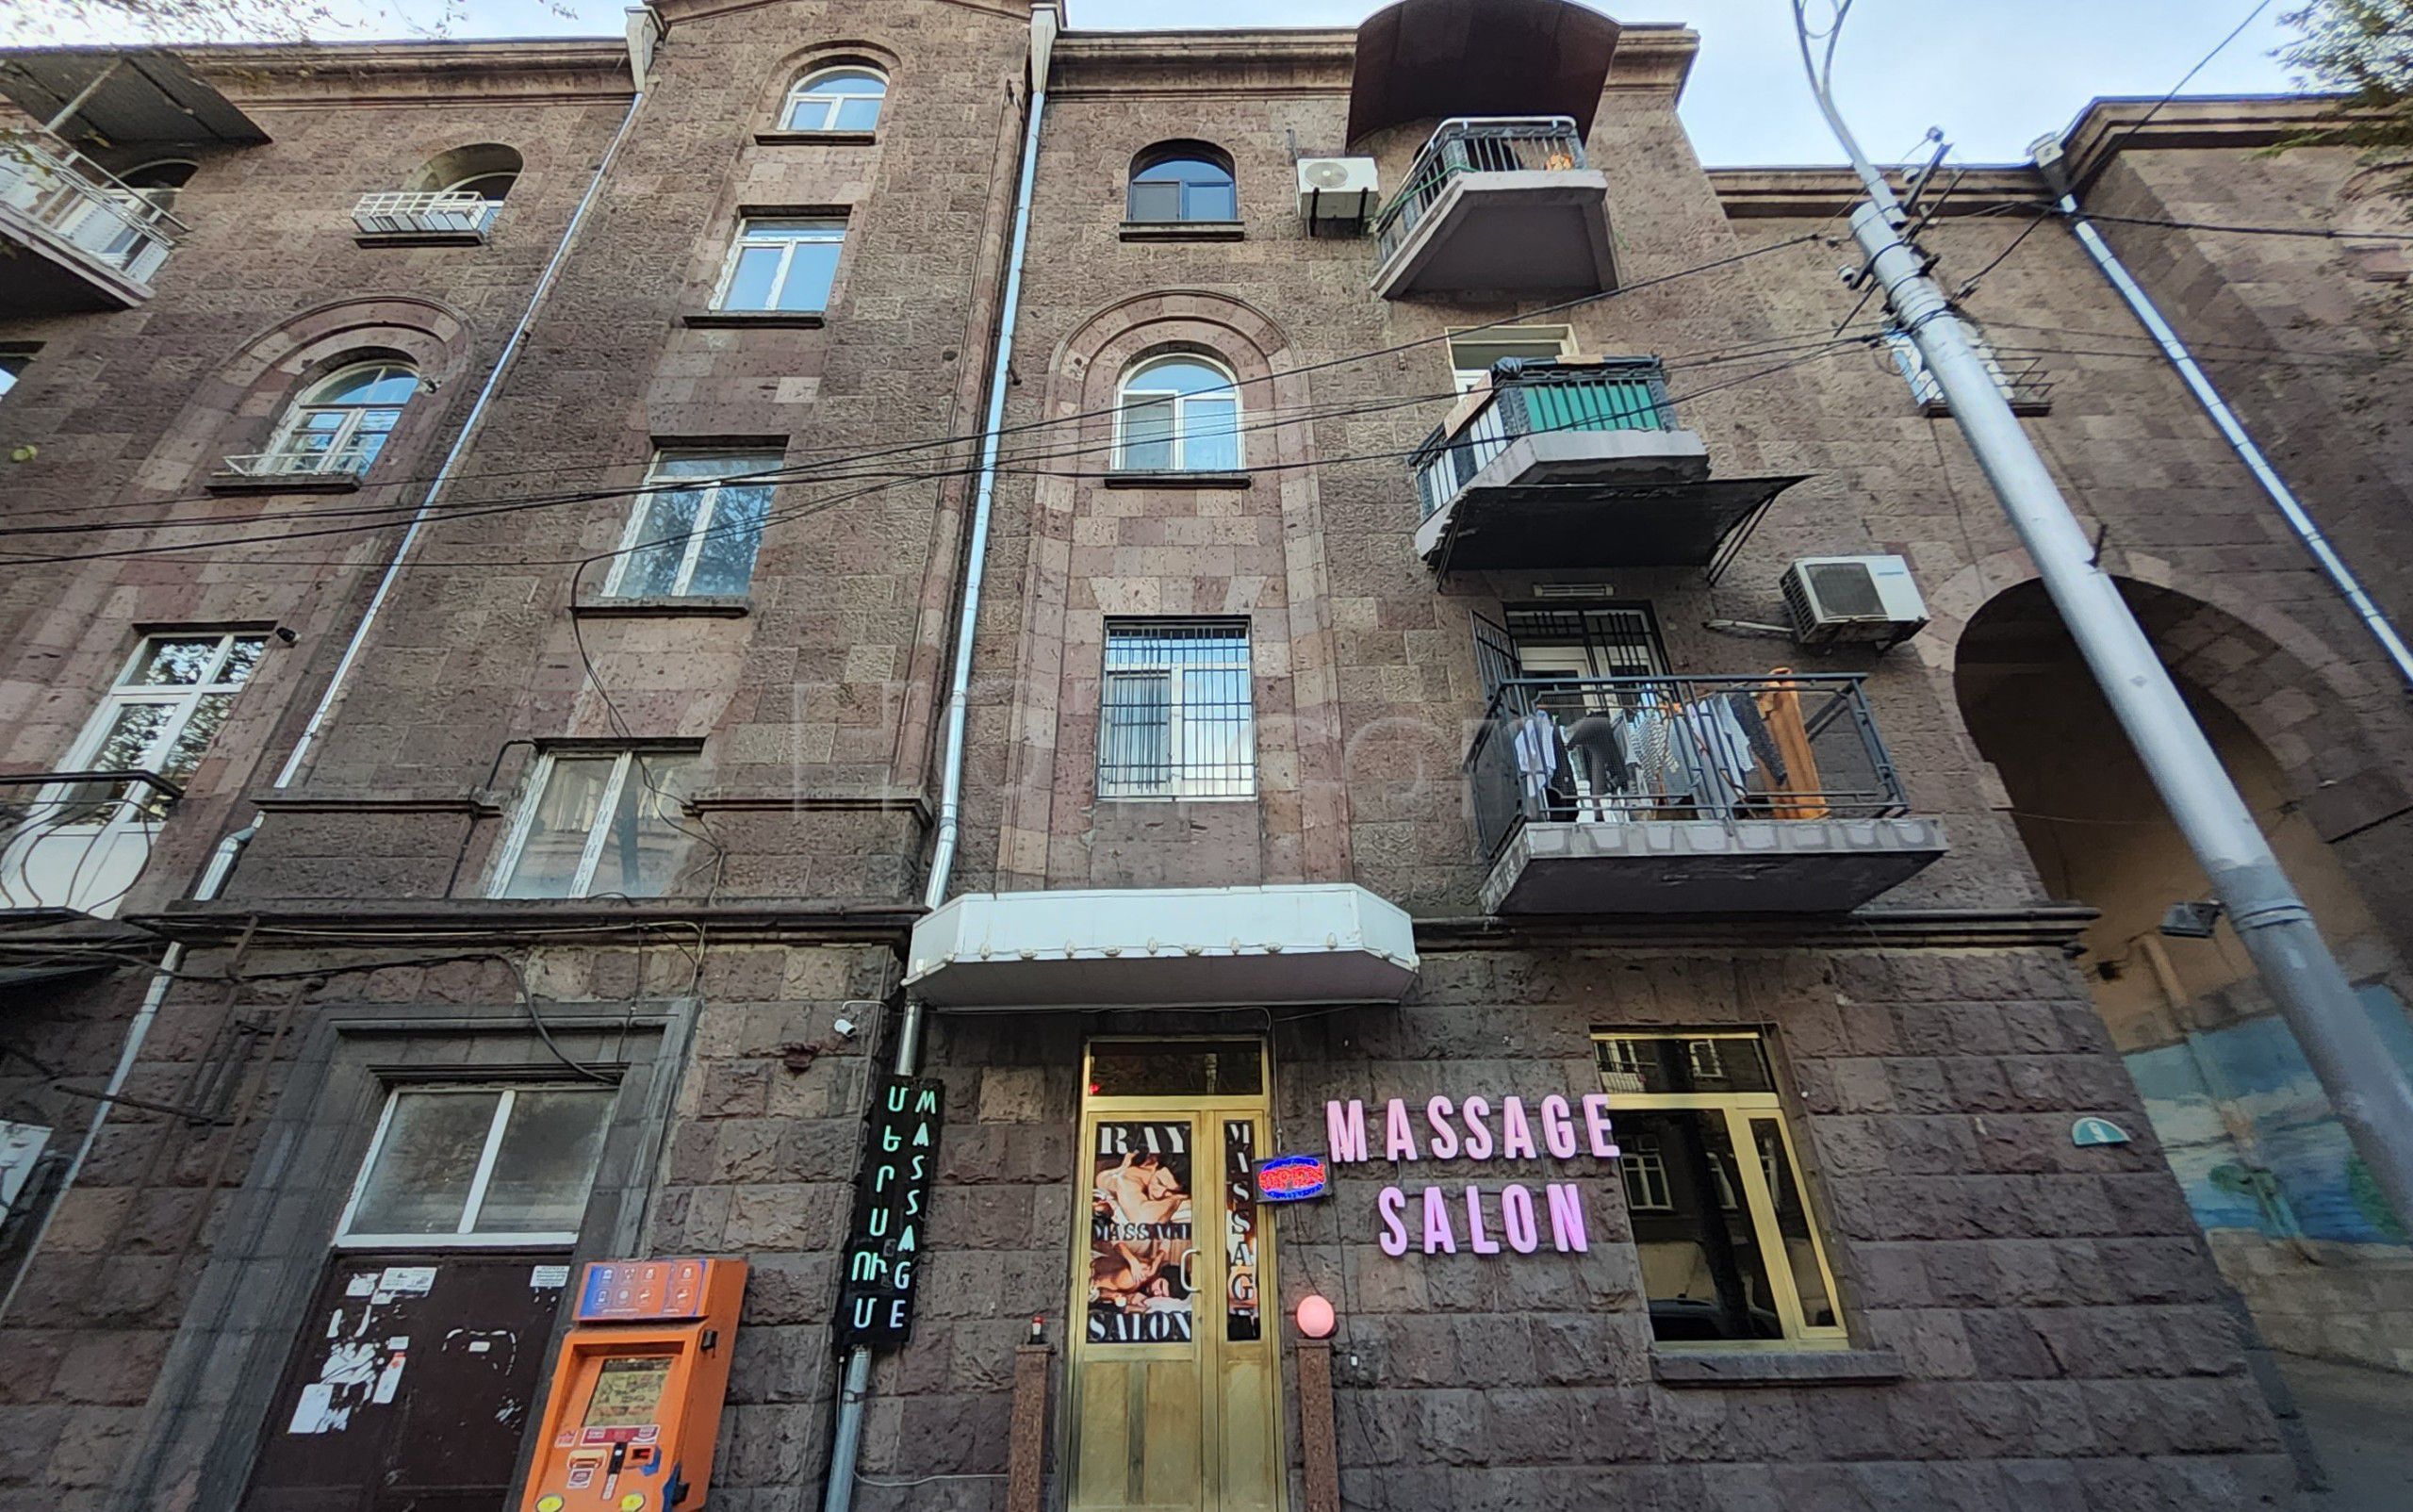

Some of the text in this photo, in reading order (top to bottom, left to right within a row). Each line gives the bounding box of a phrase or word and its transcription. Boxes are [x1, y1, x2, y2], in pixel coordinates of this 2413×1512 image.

[1099, 1126, 1191, 1154] RAY
[1327, 1093, 1620, 1163] MASSAGE
[1258, 1164, 1326, 1192] OPEN
[889, 1090, 937, 1329] MASSAGE
[1378, 1183, 1589, 1257] SALON
[1088, 1309, 1191, 1341] SALON
